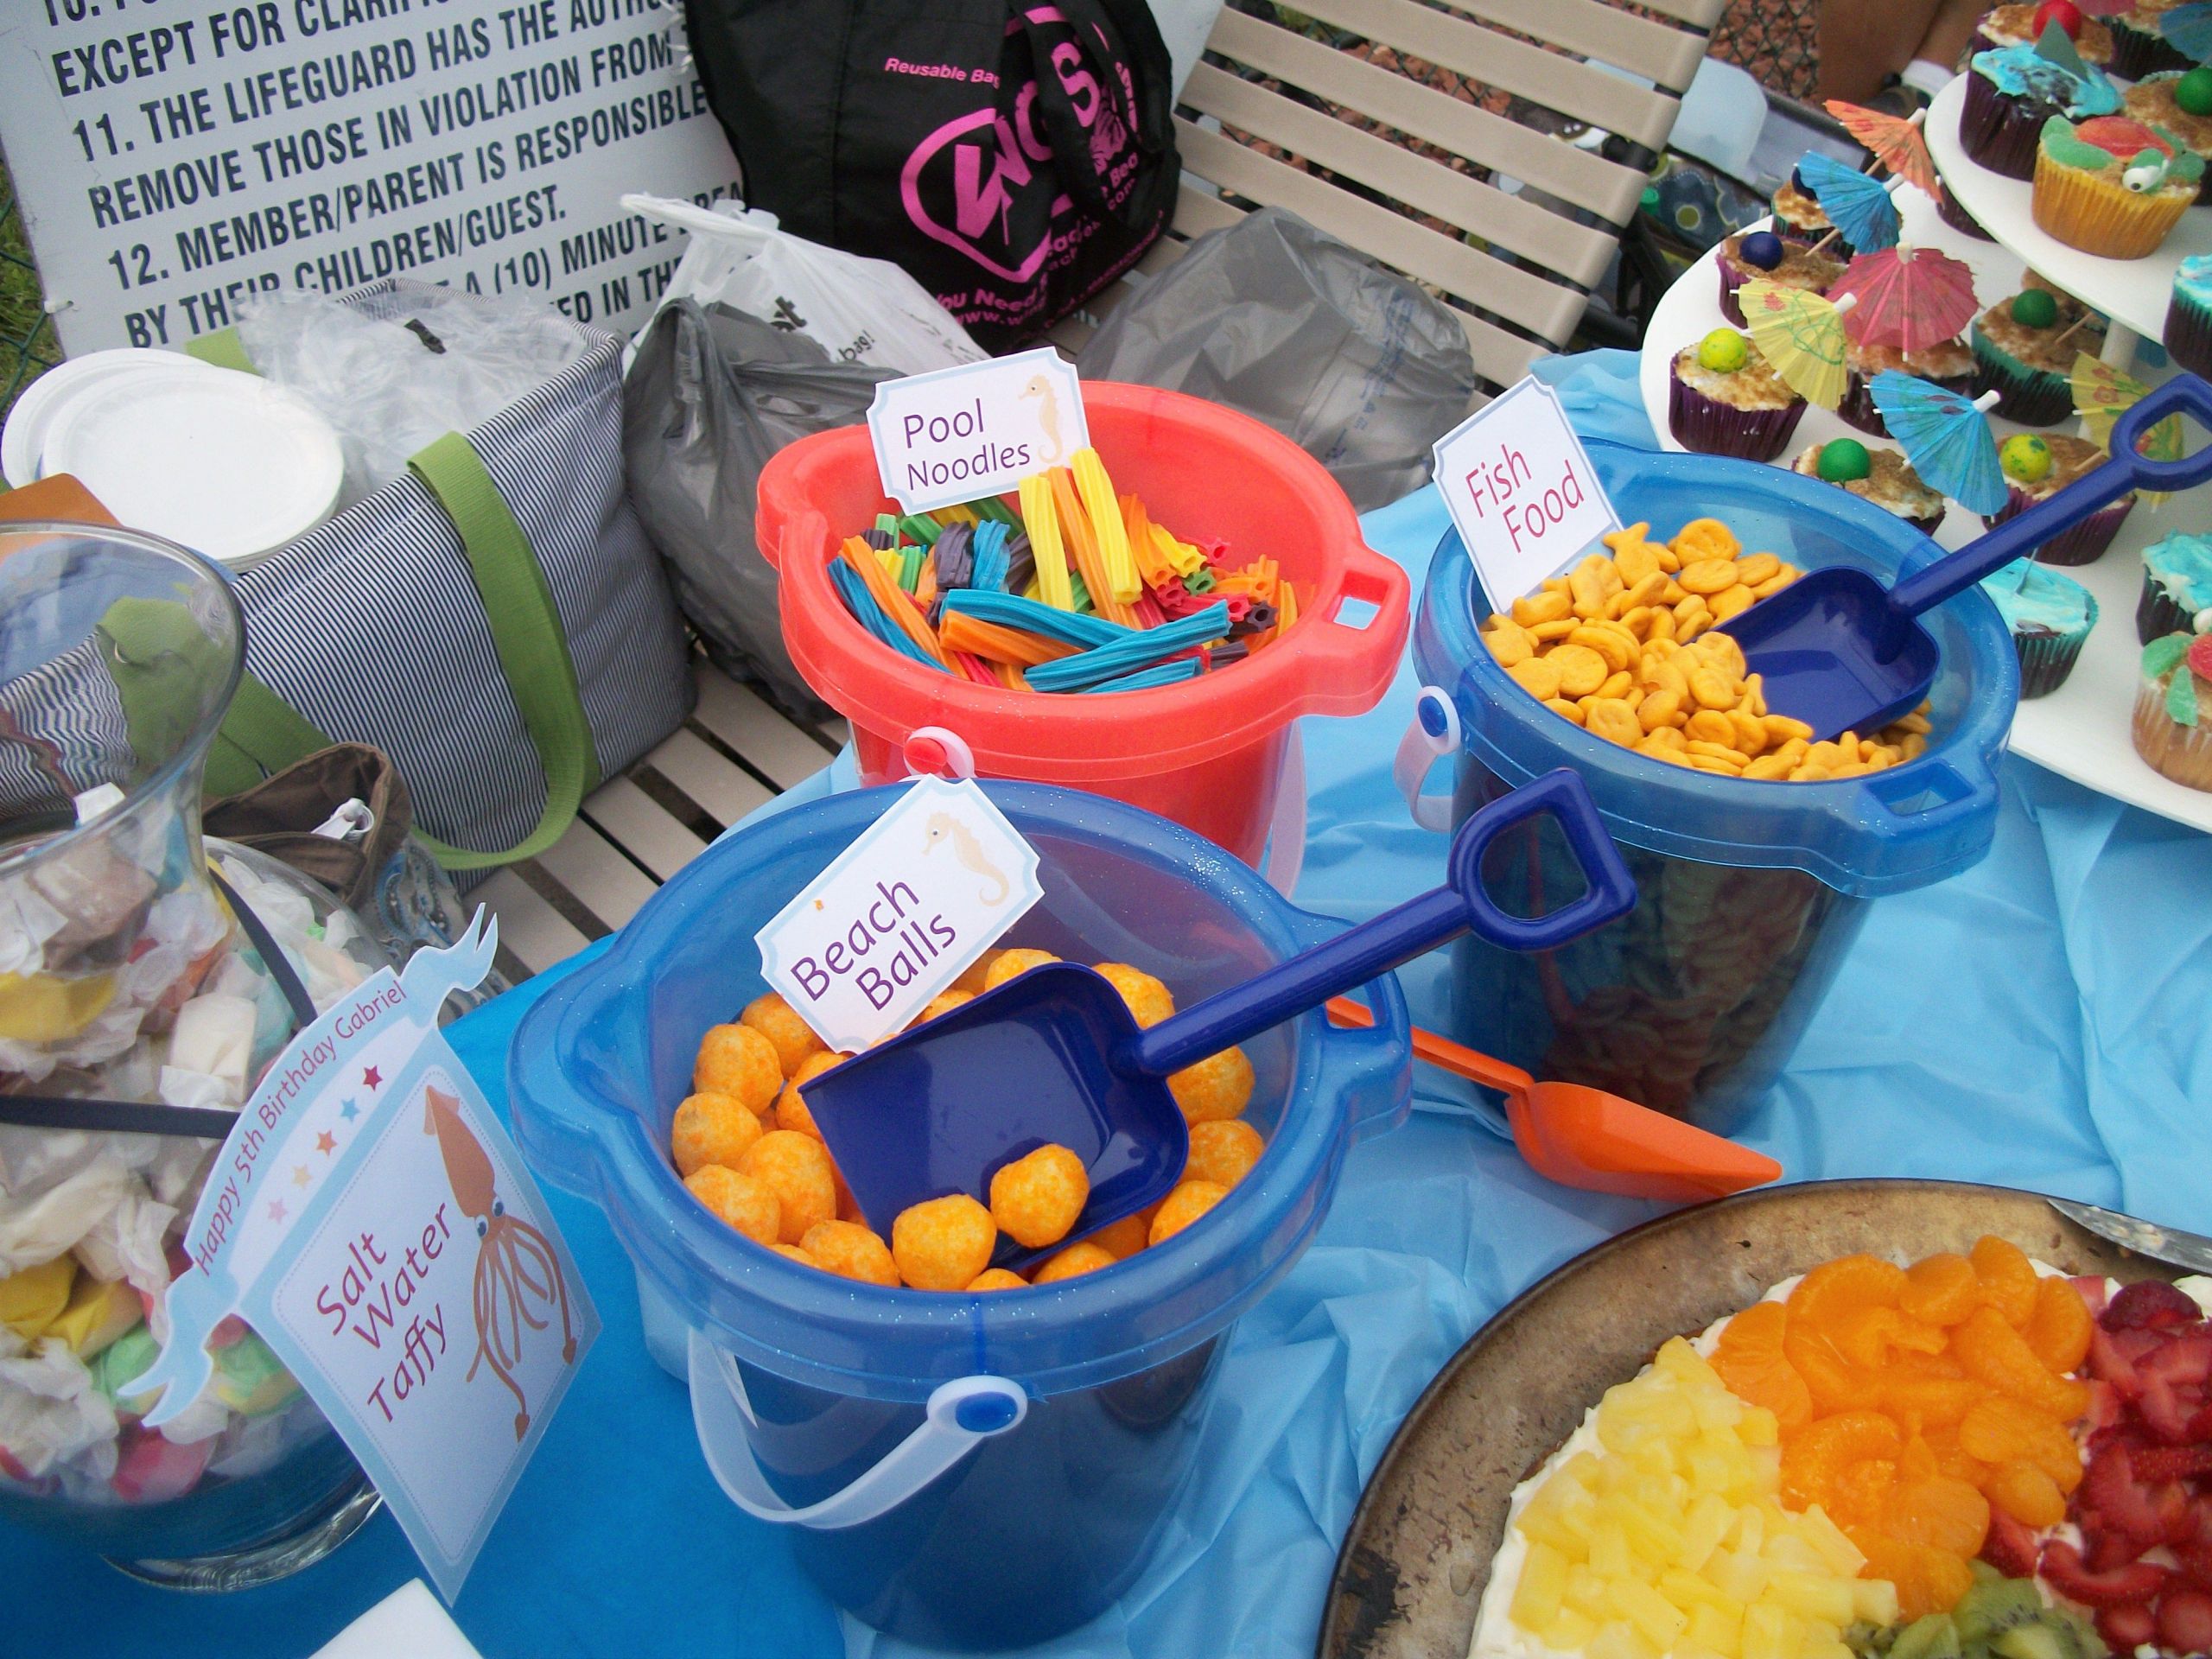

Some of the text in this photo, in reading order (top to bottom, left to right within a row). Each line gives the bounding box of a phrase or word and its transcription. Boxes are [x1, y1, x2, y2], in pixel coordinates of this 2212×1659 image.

[51, 21, 196, 97] EXCEPT
[208, 2, 286, 58] FOR
[73, 113, 135, 162] 11.
[139, 88, 215, 143] THE
[224, 37, 416, 123] LIFEGUARD
[427, 16, 492, 71] HAS
[499, 0, 559, 49] THE
[885, 57, 967, 81] Reusable
[88, 149, 247, 229] REMOVE
[252, 117, 368, 182] THOSE
[376, 105, 413, 149] IN
[420, 55, 582, 136] VIOLATION
[590, 29, 673, 88] FROM
[109, 79, 708, 289] 12. MEMBER/PARENT IS RESPONSIBLE
[124, 304, 169, 348] BY
[295, 184, 566, 294] CHILDREN/GUEST.
[601, 276, 631, 317] IN
[838, 329, 875, 361] bag!
[904, 398, 984, 448] Pool
[907, 442, 1031, 490] Noodles
[1465, 443, 1532, 518] Fish
[1503, 459, 1584, 553] Food
[790, 881, 919, 1001] Beach
[855, 914, 957, 1010] Balls
[194, 980, 407, 1277] Happy 5th Birthday Gabriel
[317, 1231, 386, 1336] Salt
[353, 1202, 450, 1349] Water
[367, 1303, 446, 1422] Taffy
